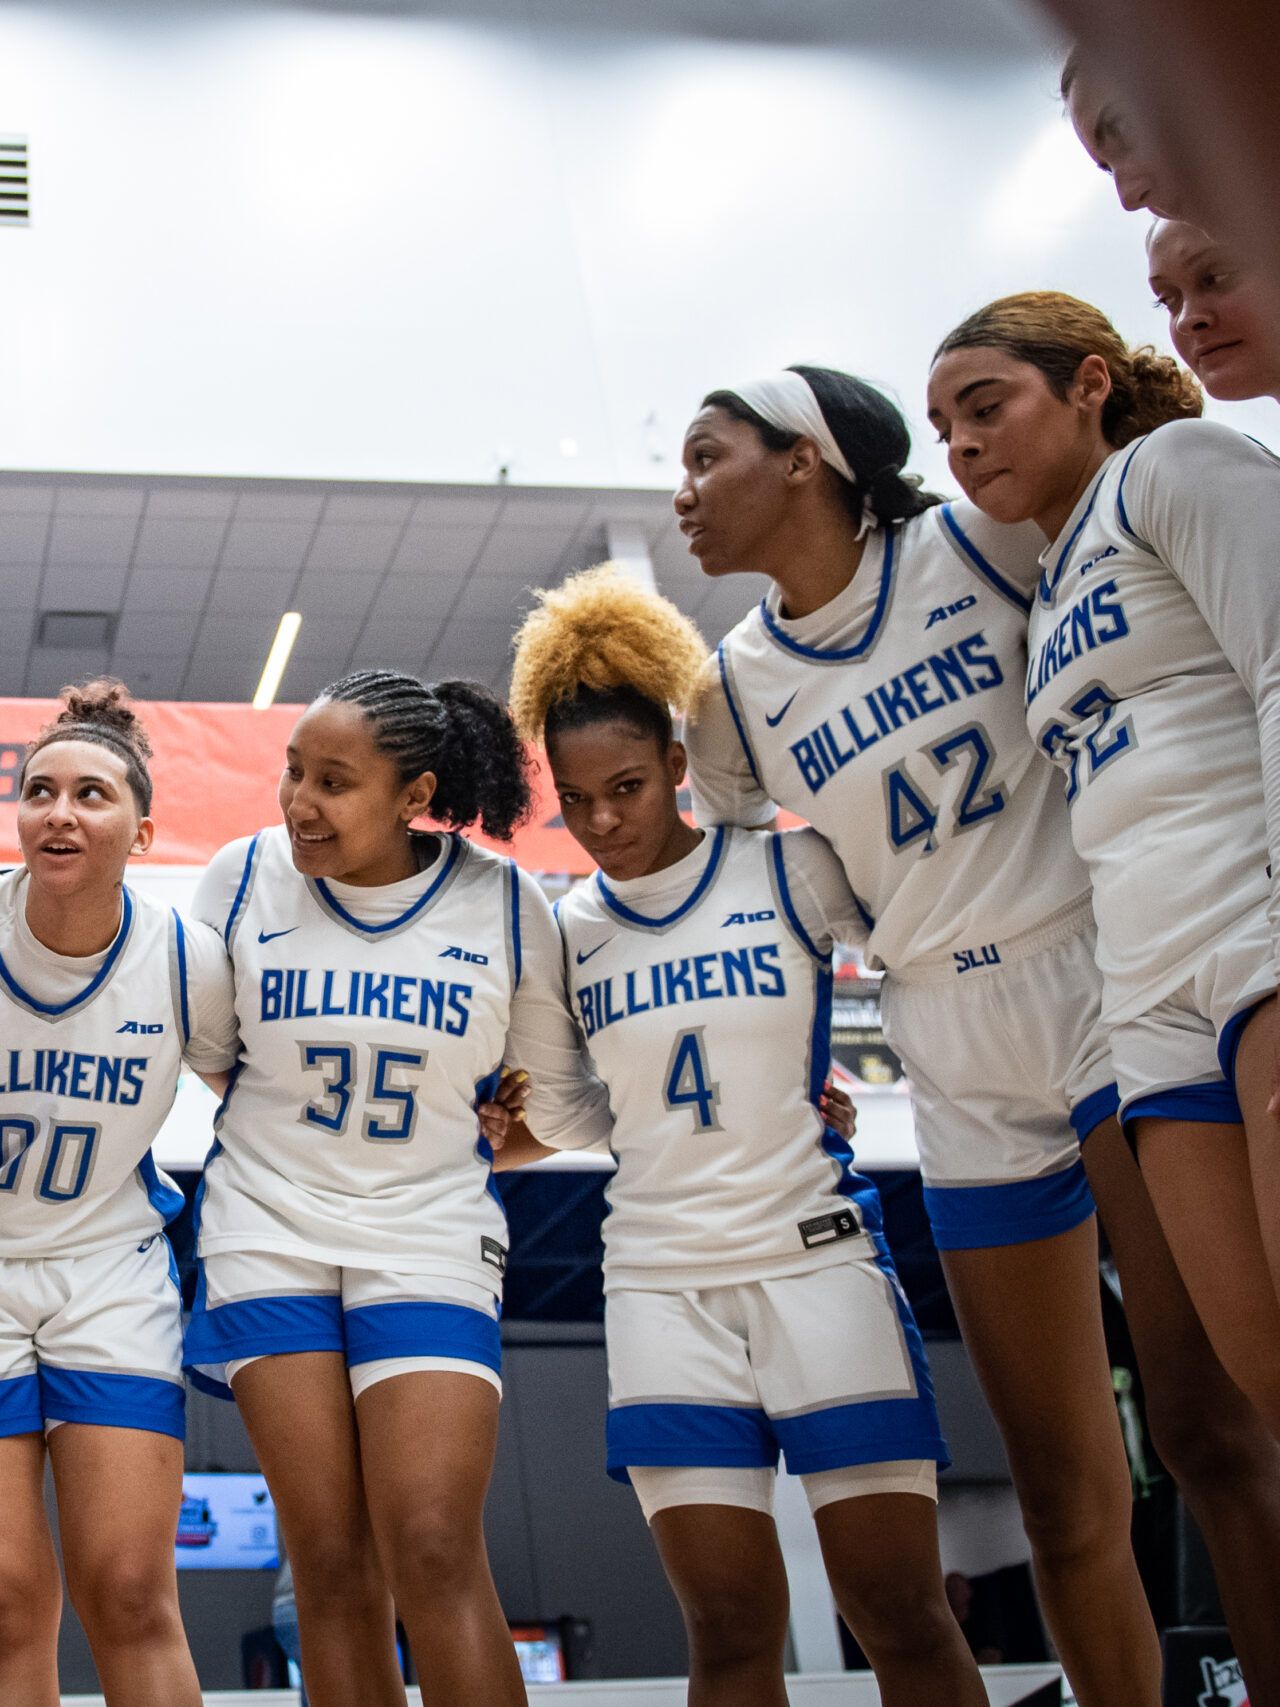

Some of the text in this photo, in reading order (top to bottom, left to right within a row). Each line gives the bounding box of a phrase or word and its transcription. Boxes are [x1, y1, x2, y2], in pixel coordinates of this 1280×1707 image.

[924, 595, 977, 630] A10
[1025, 575, 1129, 716] LIKENS
[789, 629, 1004, 796] BILLIKENS
[881, 720, 1009, 860] 42
[720, 910, 776, 928] A10
[438, 946, 488, 965] A10
[953, 943, 1001, 974] SLU
[258, 968, 475, 1037] BILLIKENS
[576, 943, 786, 1040] BILLIKENS
[115, 1021, 163, 1034] A10
[295, 1040, 428, 1144] 35
[661, 1025, 726, 1135] 4
[840, 1218, 850, 1230] S
